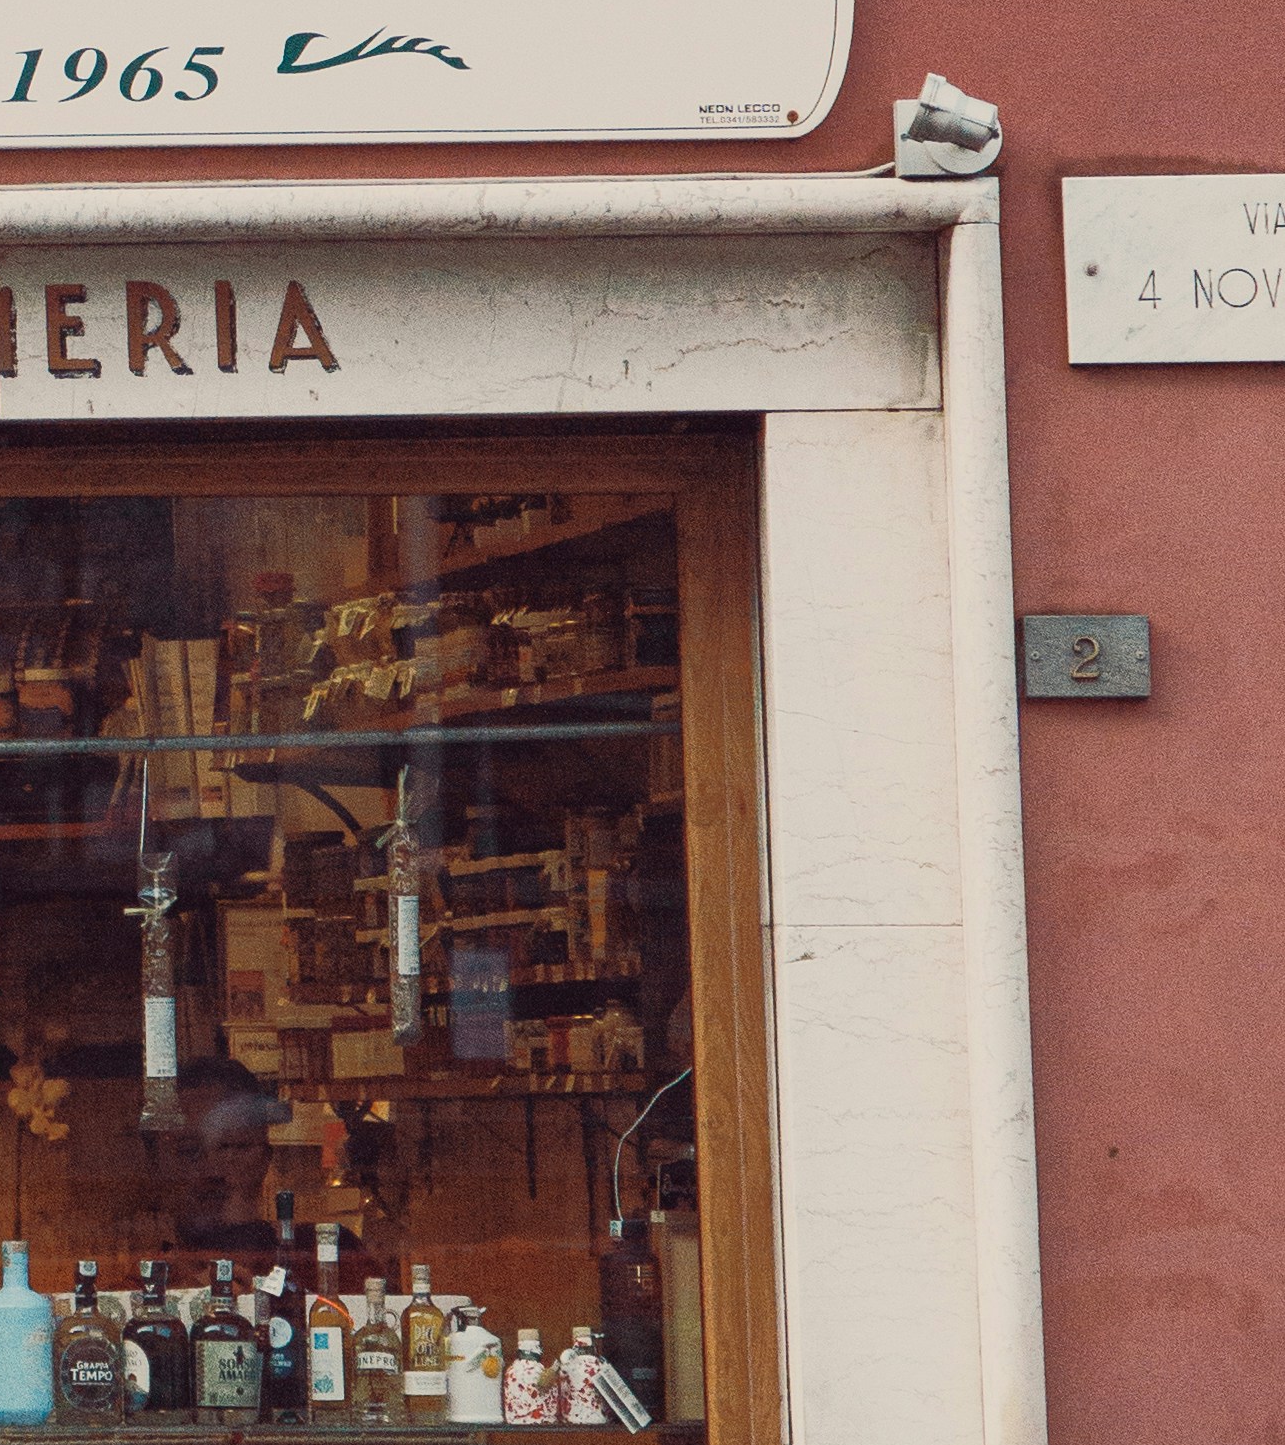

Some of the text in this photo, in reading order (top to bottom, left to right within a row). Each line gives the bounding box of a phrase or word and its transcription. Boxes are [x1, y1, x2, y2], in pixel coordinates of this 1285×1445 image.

[5, 43, 229, 106] 1965
[698, 103, 781, 114] NEON LECCO
[1138, 269, 1162, 310] 4
[1070, 635, 1102, 680] 2
[70, 1368, 114, 1382] TEMPO
